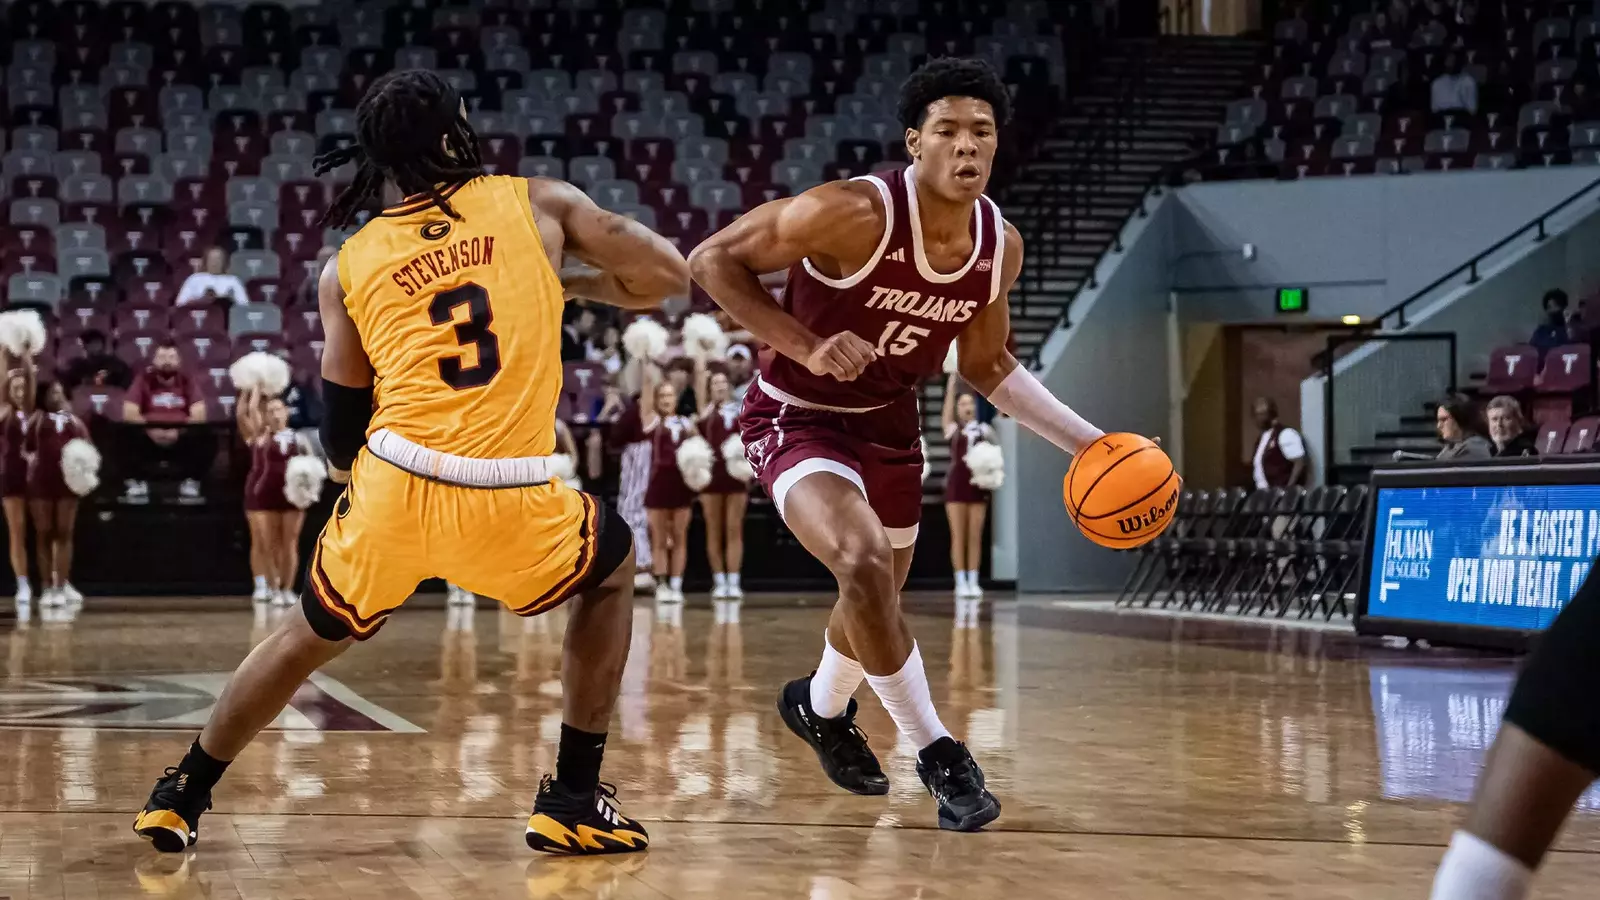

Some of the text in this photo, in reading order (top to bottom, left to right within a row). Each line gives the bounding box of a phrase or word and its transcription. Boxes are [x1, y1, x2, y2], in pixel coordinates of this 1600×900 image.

[420, 220, 450, 240] G
[392, 236, 494, 297] STEVENSON
[864, 285, 978, 323] TROJANS
[428, 281, 502, 391] 3
[874, 320, 932, 357] 15
[1504, 354, 1521, 376] T
[1562, 354, 1578, 374] T
[1117, 489, 1178, 534] Wilson
[1387, 529, 1434, 560] HUMAN
[1499, 509, 1518, 556] BE
[1518, 509, 1529, 556] A
[1531, 509, 1584, 558] FOSTER
[1447, 557, 1479, 603] OPEN
[1481, 558, 1515, 605] YOUR
